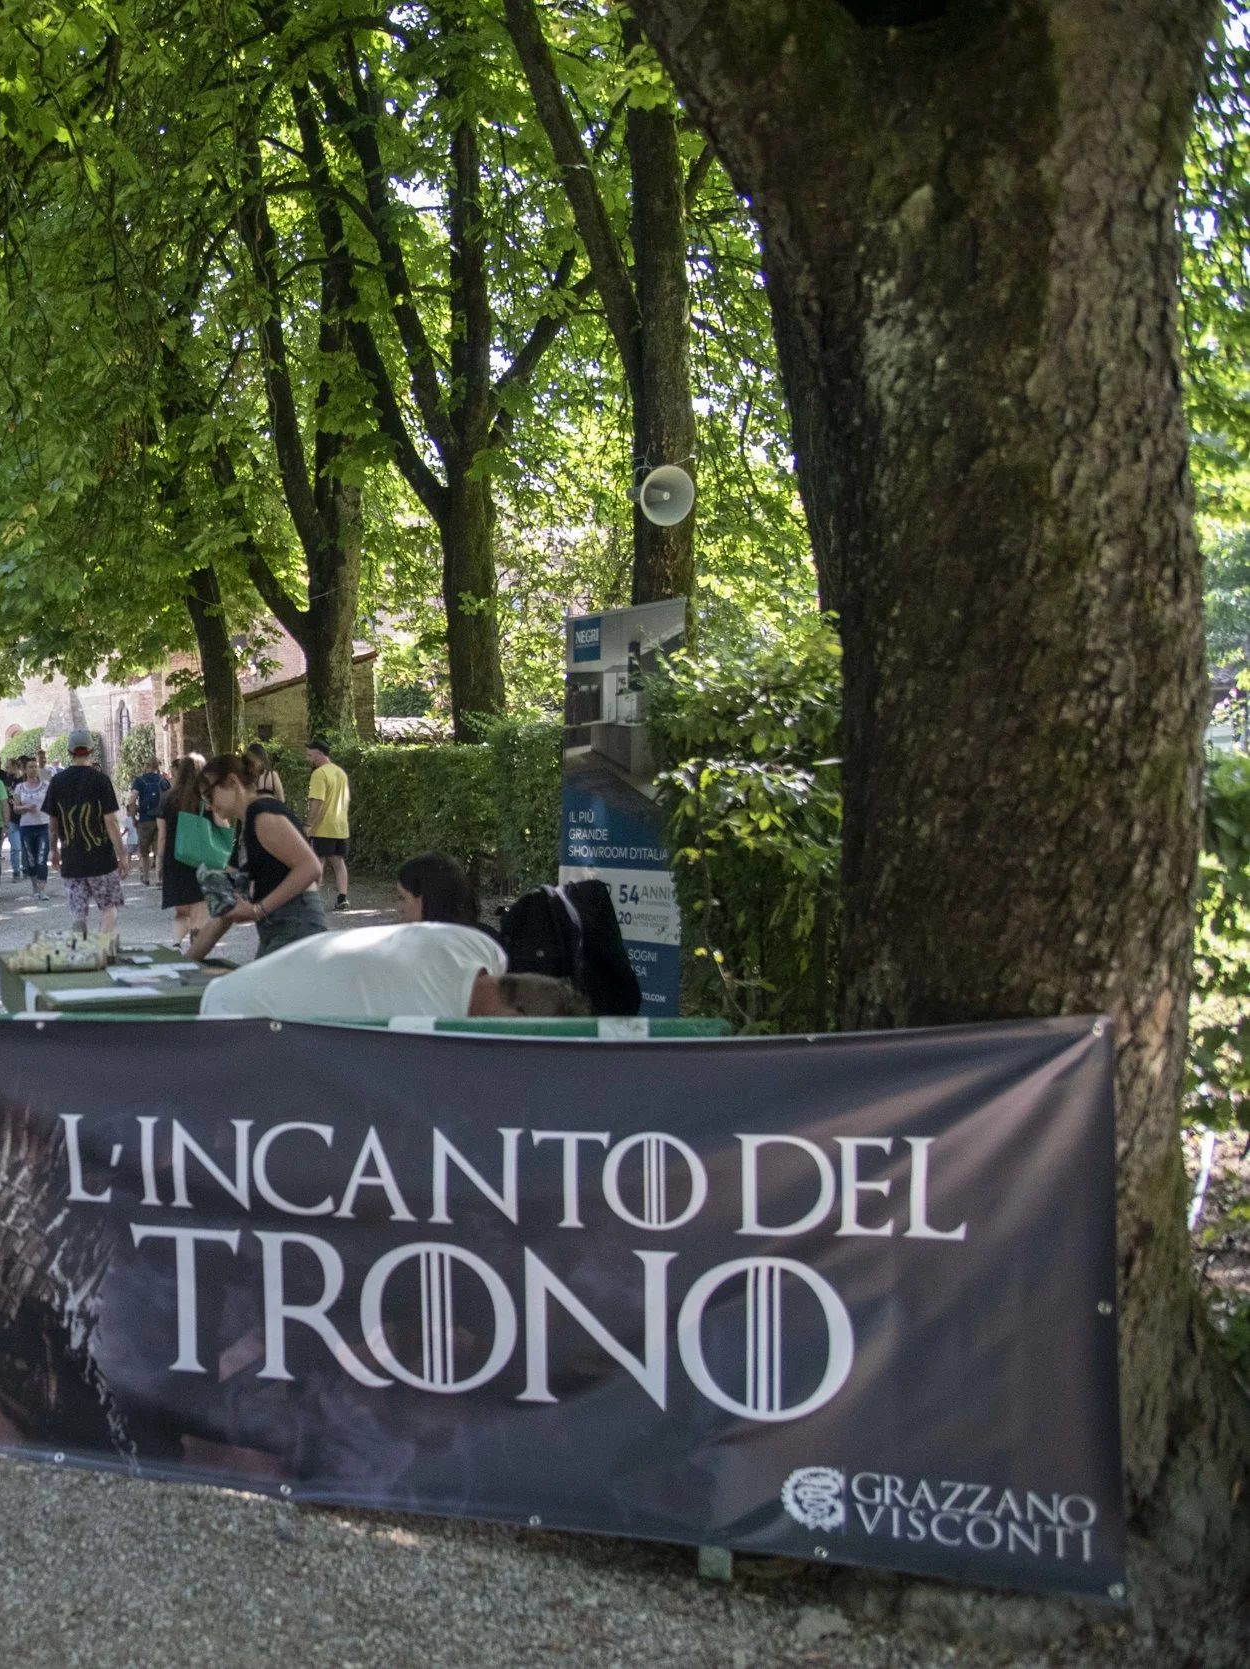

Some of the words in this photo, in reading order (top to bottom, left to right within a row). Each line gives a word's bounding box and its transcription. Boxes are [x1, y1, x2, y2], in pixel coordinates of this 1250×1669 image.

[575, 628, 599, 644] NEGRI
[568, 812, 577, 824] IL
[578, 809, 594, 824] PIÙ
[568, 828, 609, 841] GRANDE
[568, 846, 628, 859] SHOWROOM
[629, 848, 669, 861] D'ITALIA
[618, 883, 640, 905] 54
[640, 885, 671, 900] ANNI
[627, 949, 658, 963] SOGNI
[630, 965, 647, 977] SA
[59, 1112, 709, 1231] L'INCANTO
[733, 1132, 968, 1241] DEL
[130, 1223, 855, 1423] TRONO
[850, 1471, 1098, 1530] GRAZZANO
[855, 1502, 1092, 1563] VISCONTI
